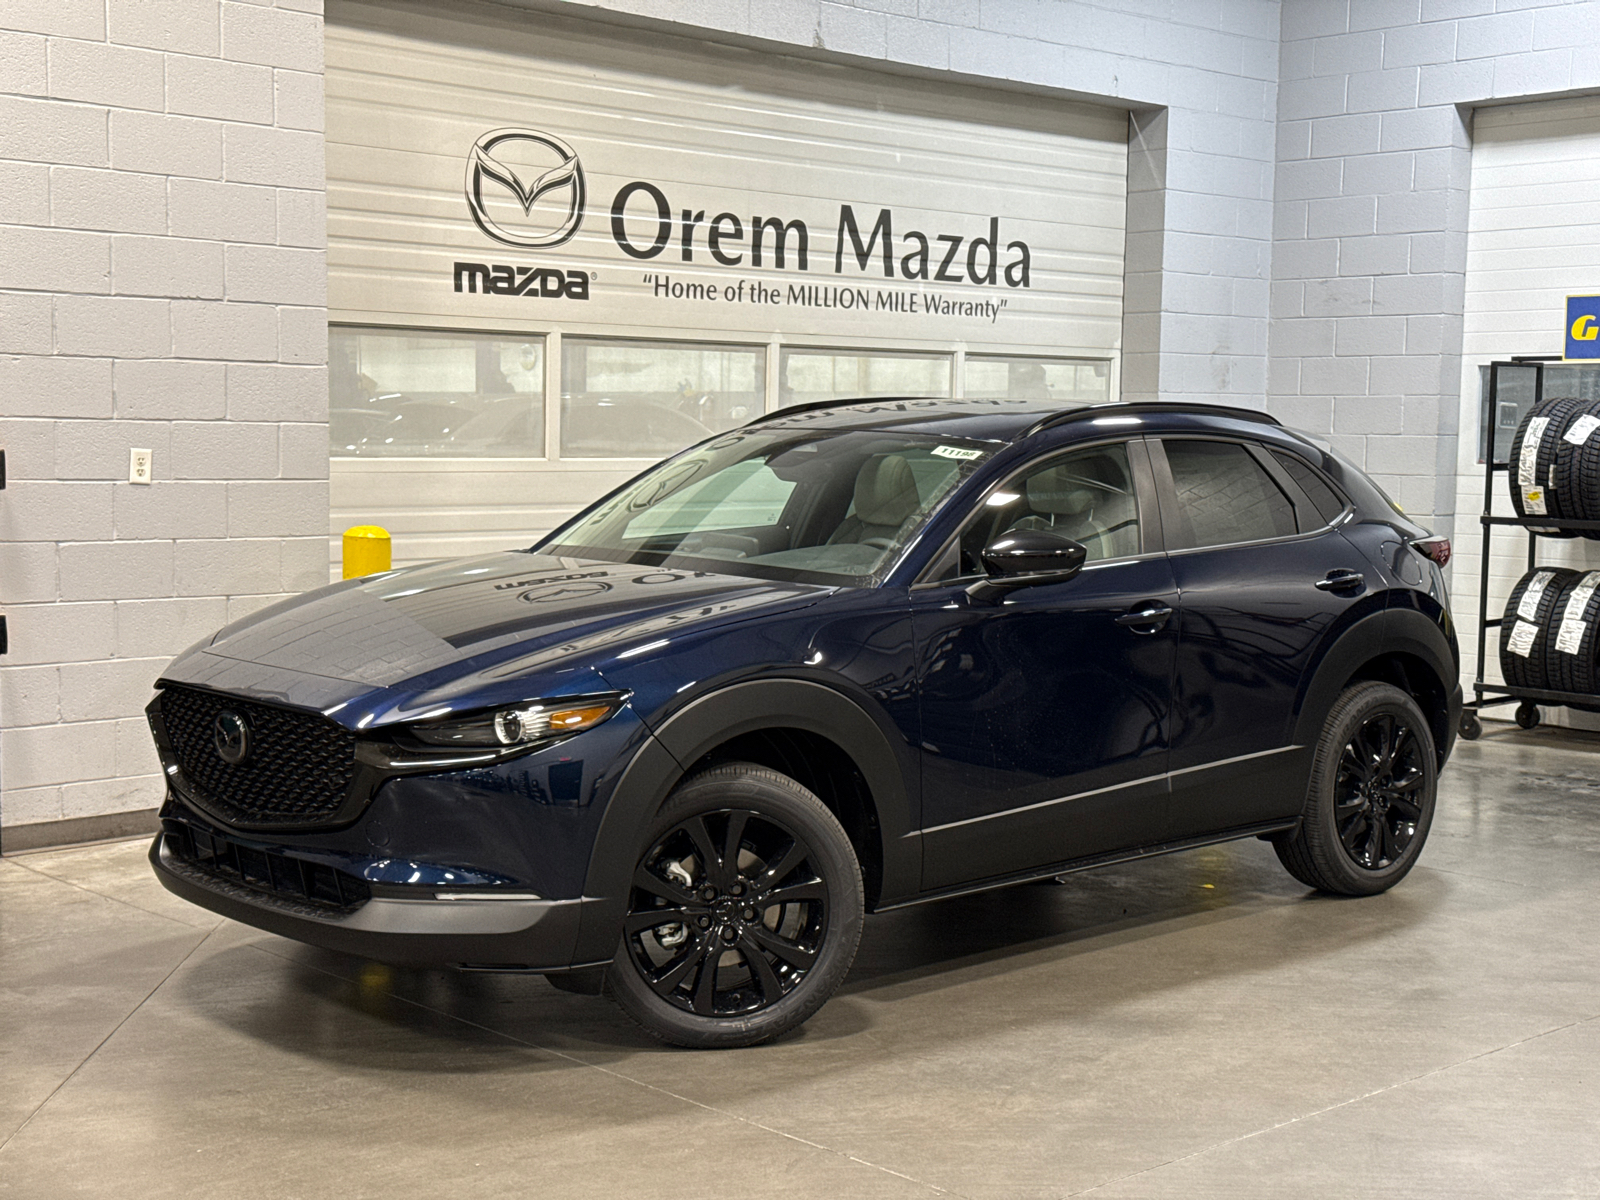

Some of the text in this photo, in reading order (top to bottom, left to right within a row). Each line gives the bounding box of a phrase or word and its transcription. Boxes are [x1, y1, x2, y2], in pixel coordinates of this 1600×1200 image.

[610, 181, 1031, 288] Orem Mazda
[643, 274, 1008, 324] “Home of the MILLION MILE Warranty”
